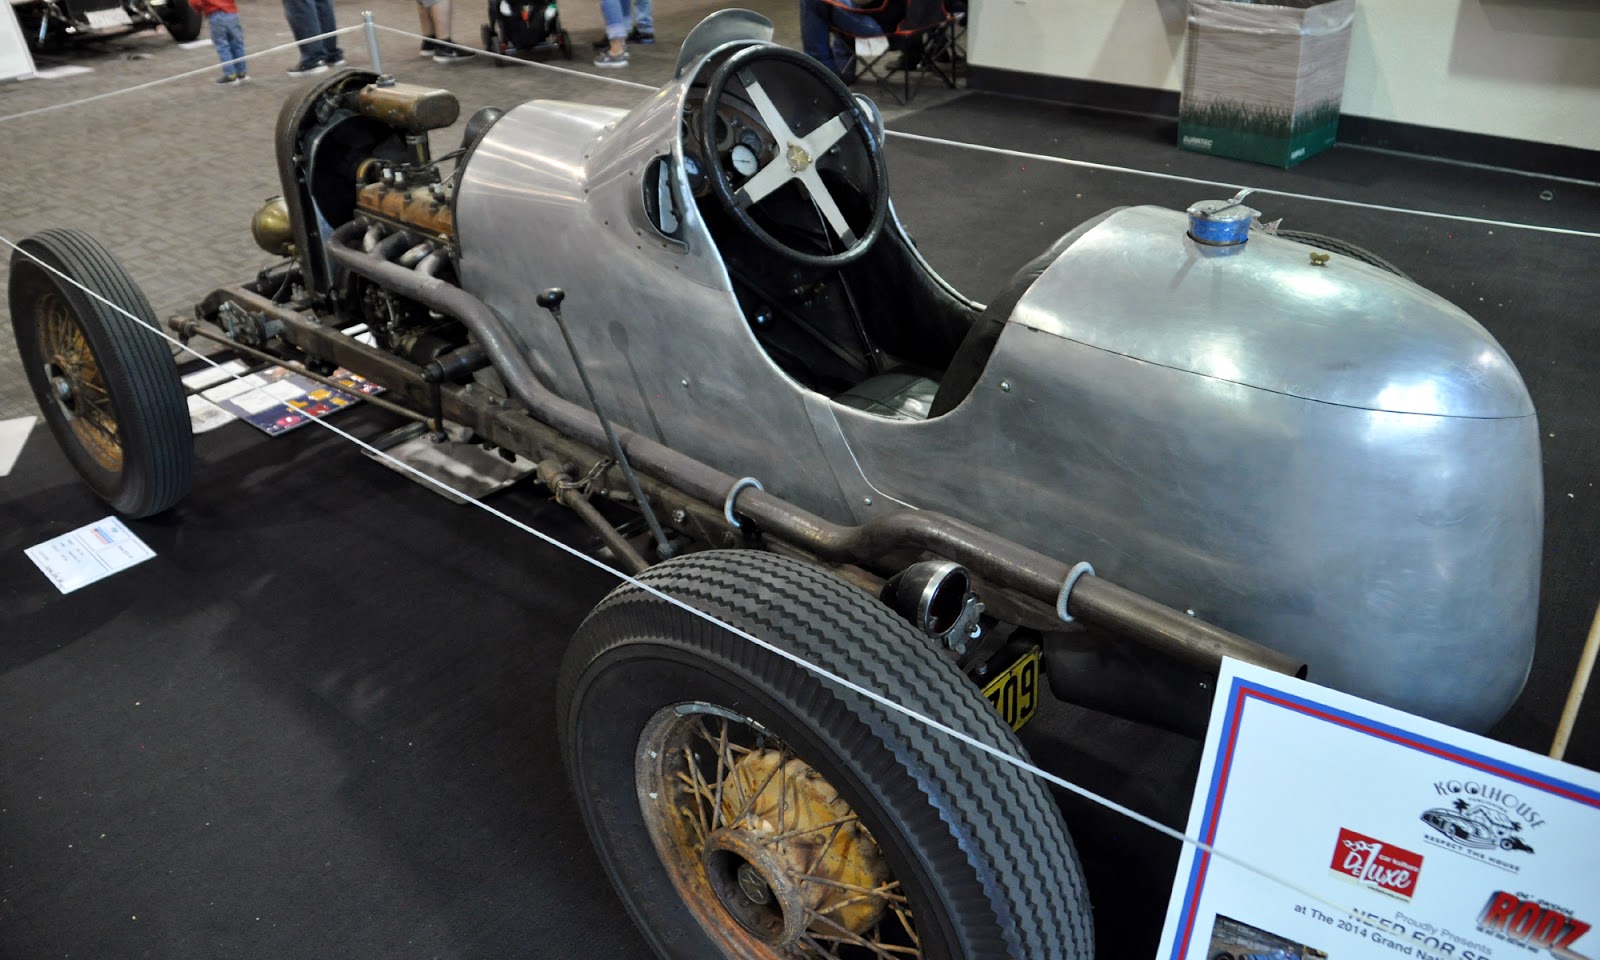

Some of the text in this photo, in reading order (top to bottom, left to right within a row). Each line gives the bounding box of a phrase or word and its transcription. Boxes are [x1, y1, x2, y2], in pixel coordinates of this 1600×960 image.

[1433, 779, 1546, 829] KOOLHOUSE
[1424, 834, 1520, 872] RESPECT THE HOUSE
[1294, 904, 1307, 915] at
[1311, 908, 1334, 925] The
[1337, 919, 1368, 938] 2014
[1371, 932, 1413, 955] Grand
[1395, 911, 1438, 935] Proudly
[1440, 928, 1493, 956] Presents
[1477, 890, 1593, 960] RODZ
